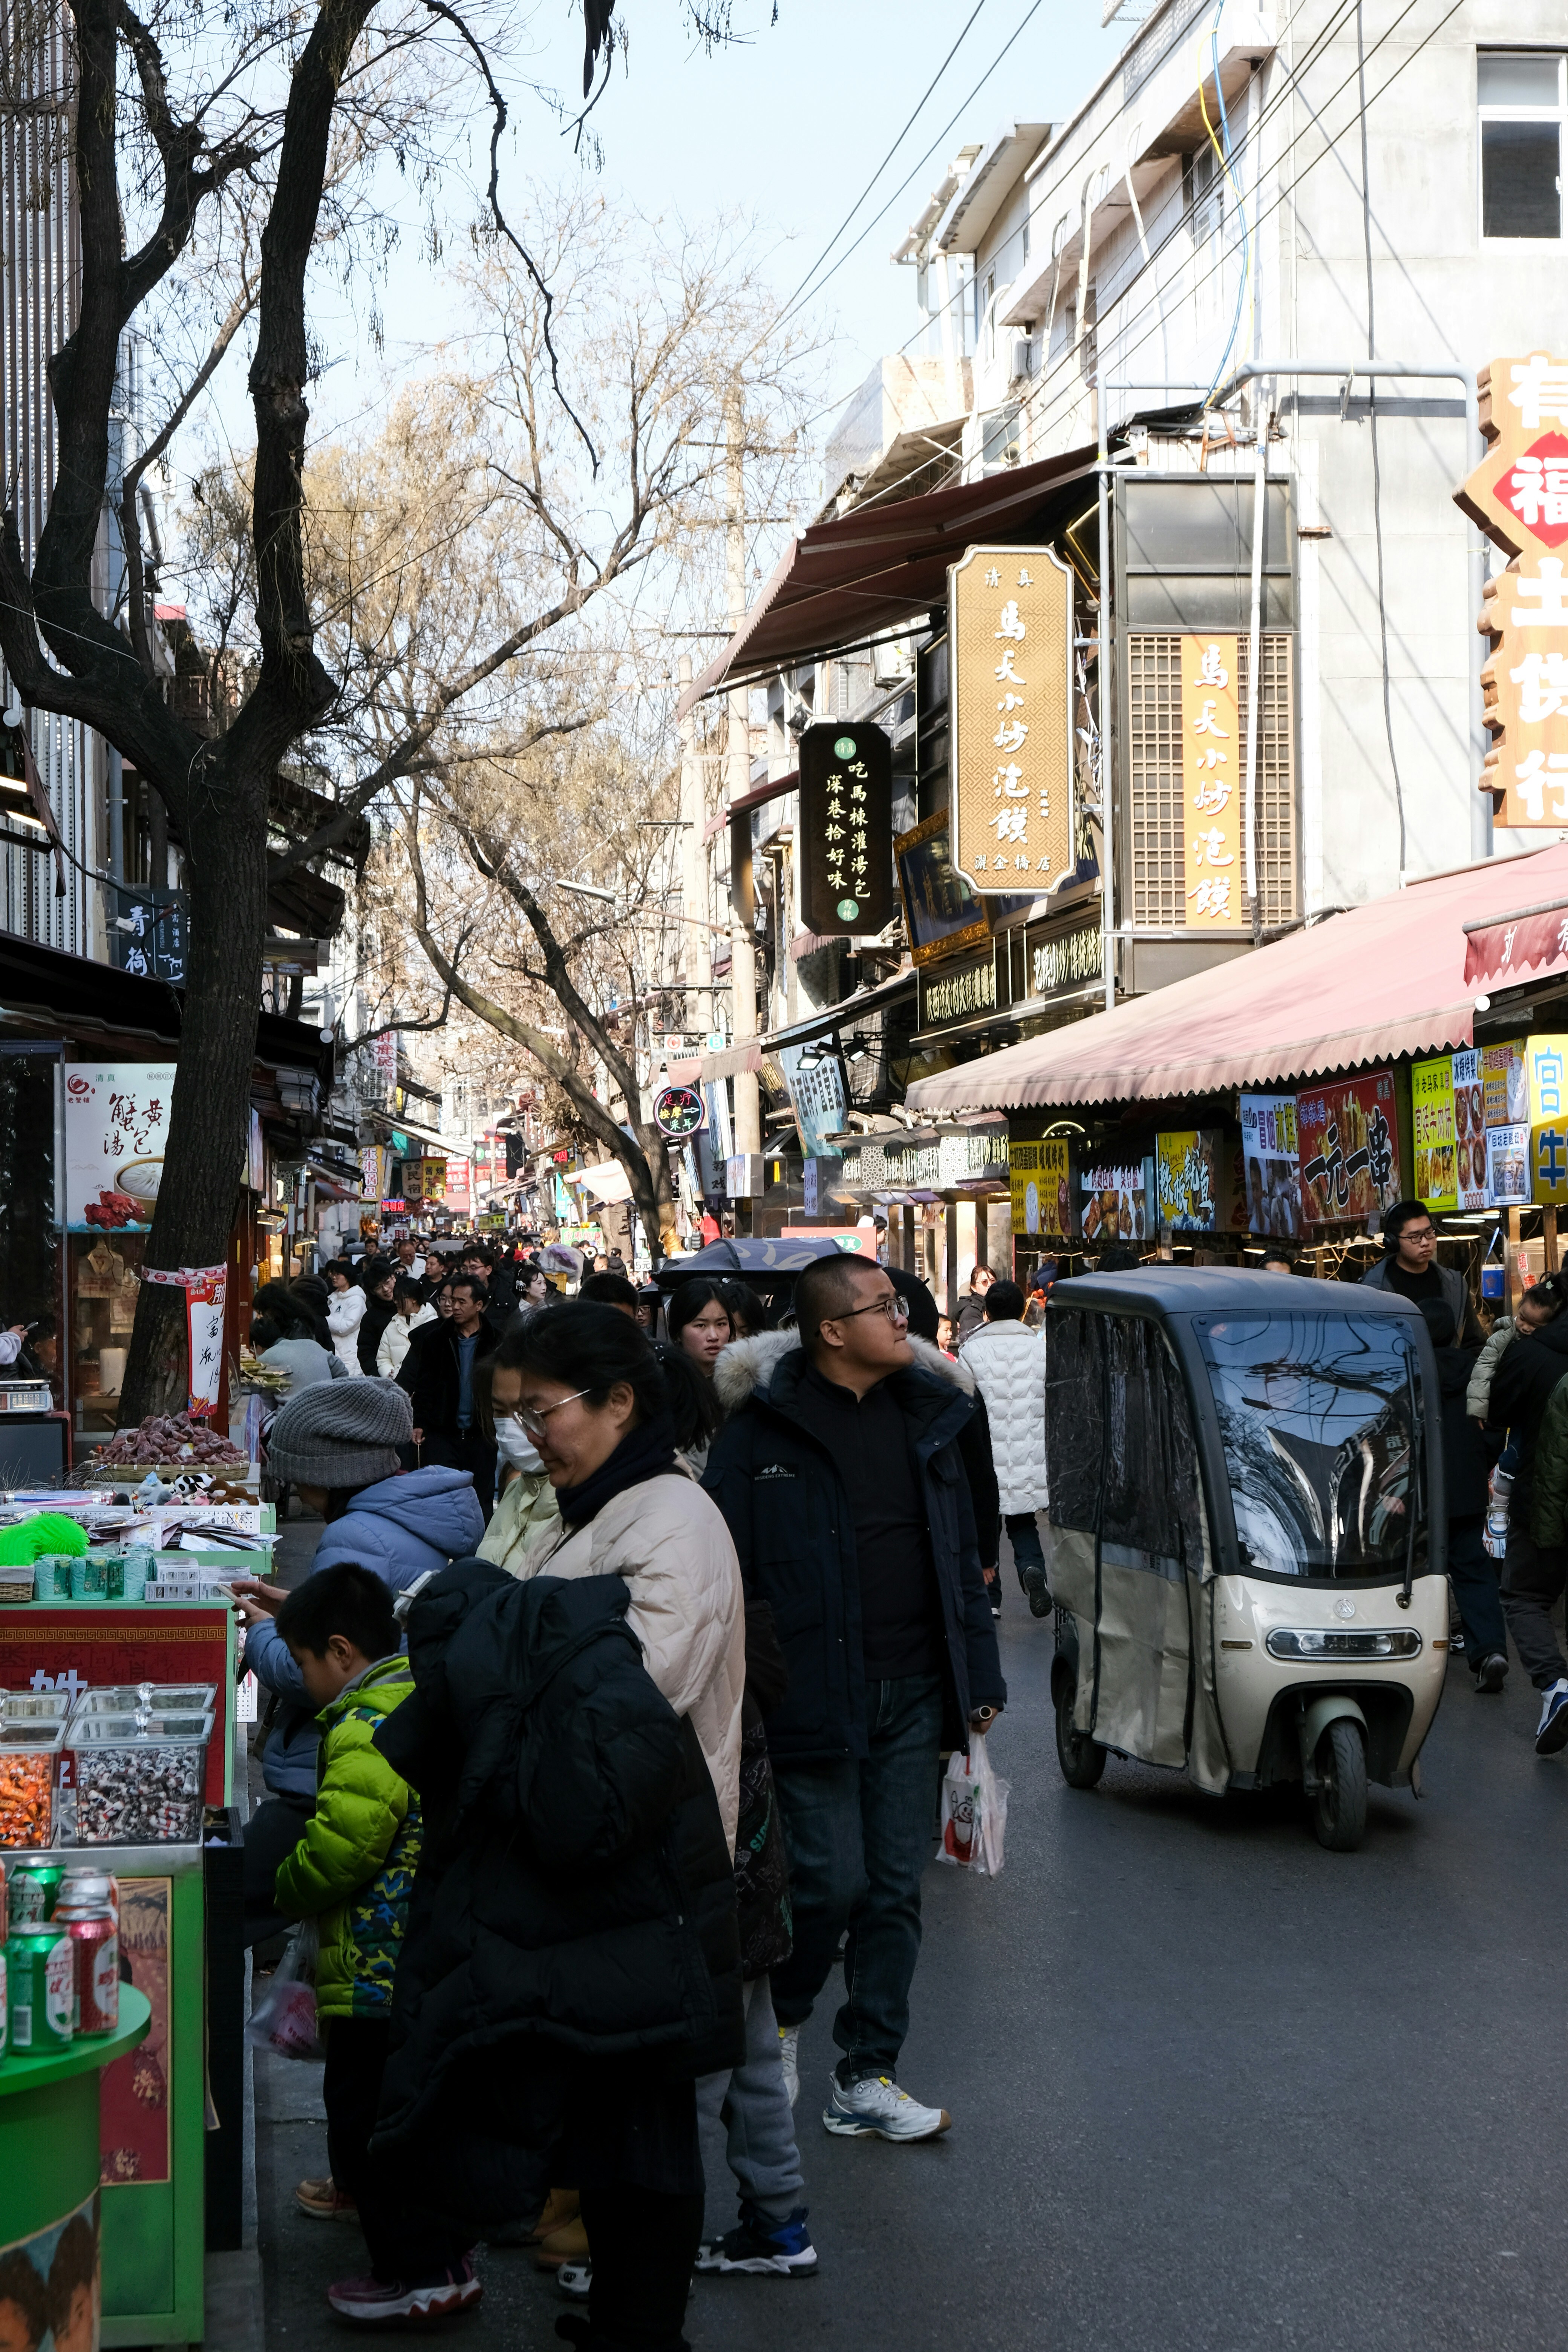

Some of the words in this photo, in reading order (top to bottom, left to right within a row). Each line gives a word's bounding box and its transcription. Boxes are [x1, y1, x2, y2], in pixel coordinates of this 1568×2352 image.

[985, 567, 1034, 587] 清真
[825, 774, 847, 890] 深巷拾好味
[669, 1037, 678, 1048] C
[713, 1036, 720, 1047] B
[96, 1074, 115, 1082] 清真
[1454, 1053, 1476, 1083] 冰糖烤梨
[1422, 1072, 1438, 1093] 老马家
[1535, 1047, 1563, 1115] 宫
[662, 1092, 691, 1107] 足疗
[659, 1106, 682, 1119] 按摩
[670, 1118, 693, 1131] 采耳
[553, 1149, 567, 1162] 烟
[1305, 1106, 1392, 1210] 一元一串
[1539, 1129, 1565, 1189] 牛
[407, 1171, 421, 1194] 民宿
[636, 1262, 651, 1270] 5元
[206, 1315, 219, 1338] 富
